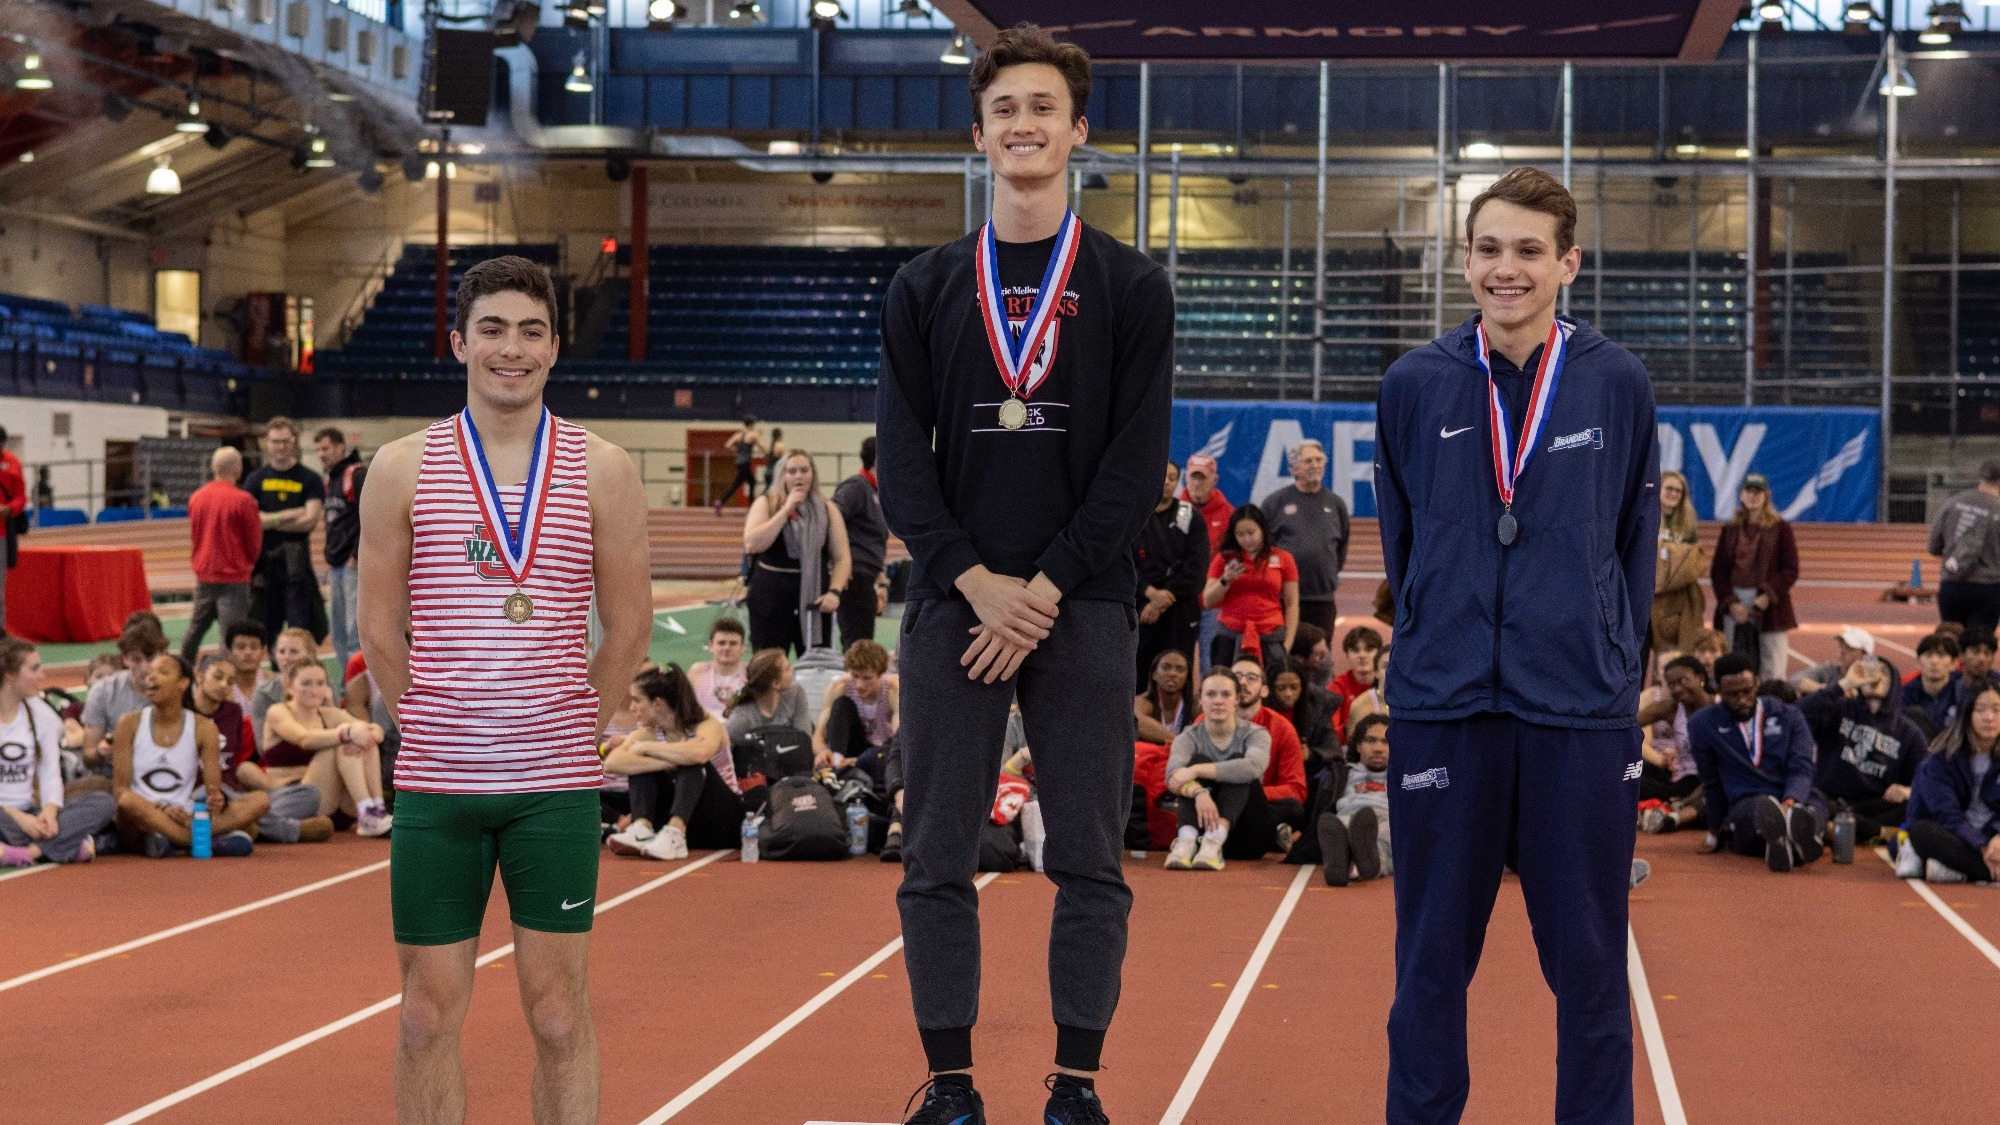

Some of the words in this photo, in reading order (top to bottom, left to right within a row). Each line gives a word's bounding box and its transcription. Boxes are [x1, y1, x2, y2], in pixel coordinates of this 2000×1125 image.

[1142, 25, 1527, 37] ARMORY
[1013, 286, 1039, 296] Mellon
[976, 297, 1079, 316] RTNS
[464, 537, 502, 562] WA
